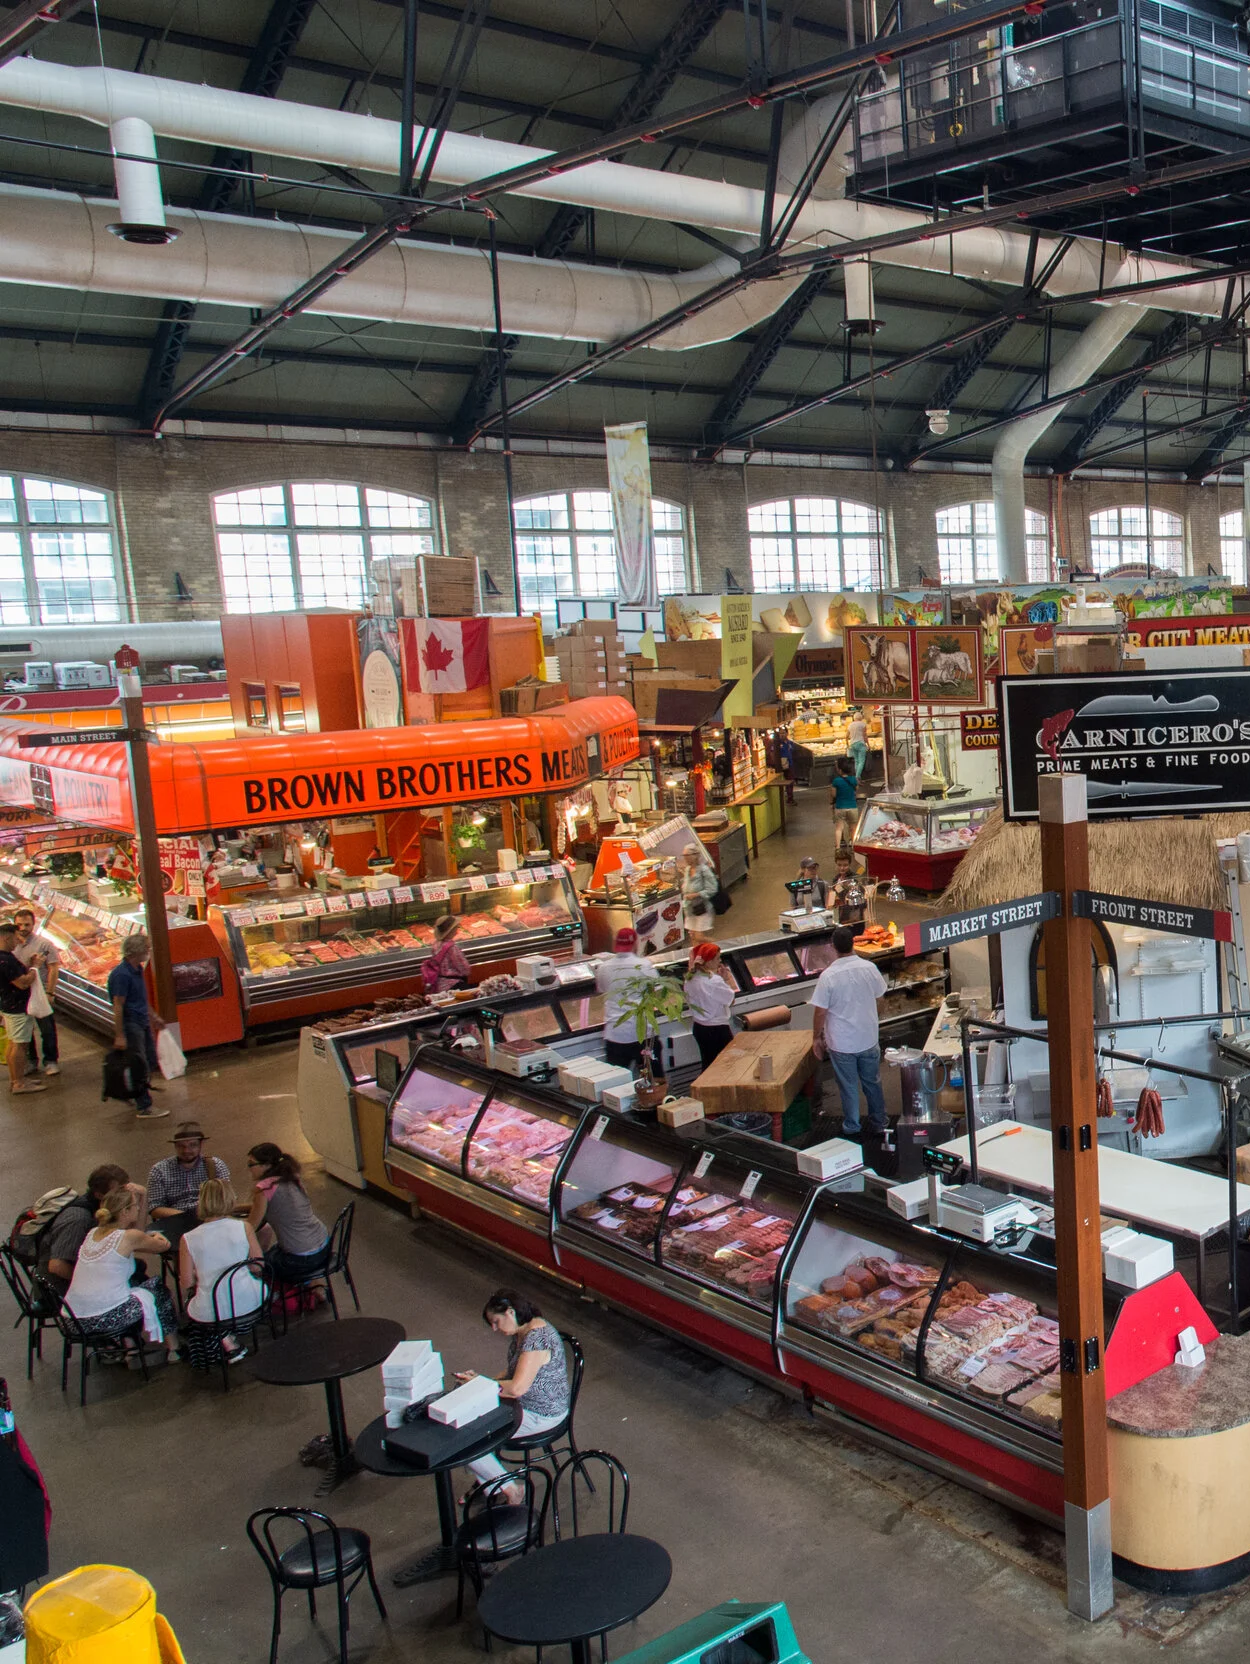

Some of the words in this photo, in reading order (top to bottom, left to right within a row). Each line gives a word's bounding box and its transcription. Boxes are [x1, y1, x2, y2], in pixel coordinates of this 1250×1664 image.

[1148, 629, 1190, 647] CUT
[51, 736, 77, 744] MAIN
[80, 732, 118, 742] STREET
[609, 727, 635, 763] POULTRY
[965, 734, 1000, 746] COUN
[1037, 760, 1081, 772] PRIME
[1090, 757, 1137, 770] MEATS
[1146, 757, 1156, 768] &
[1166, 755, 1198, 767] FINE
[244, 770, 366, 814] BROWN
[376, 754, 532, 802] BROTHERS
[541, 744, 586, 783] MEATS
[174, 854, 200, 868] Bacon
[928, 913, 988, 943] MARKET
[991, 901, 1042, 927] STREET
[1091, 899, 1135, 920] FRONT
[1140, 906, 1194, 929] STREET
